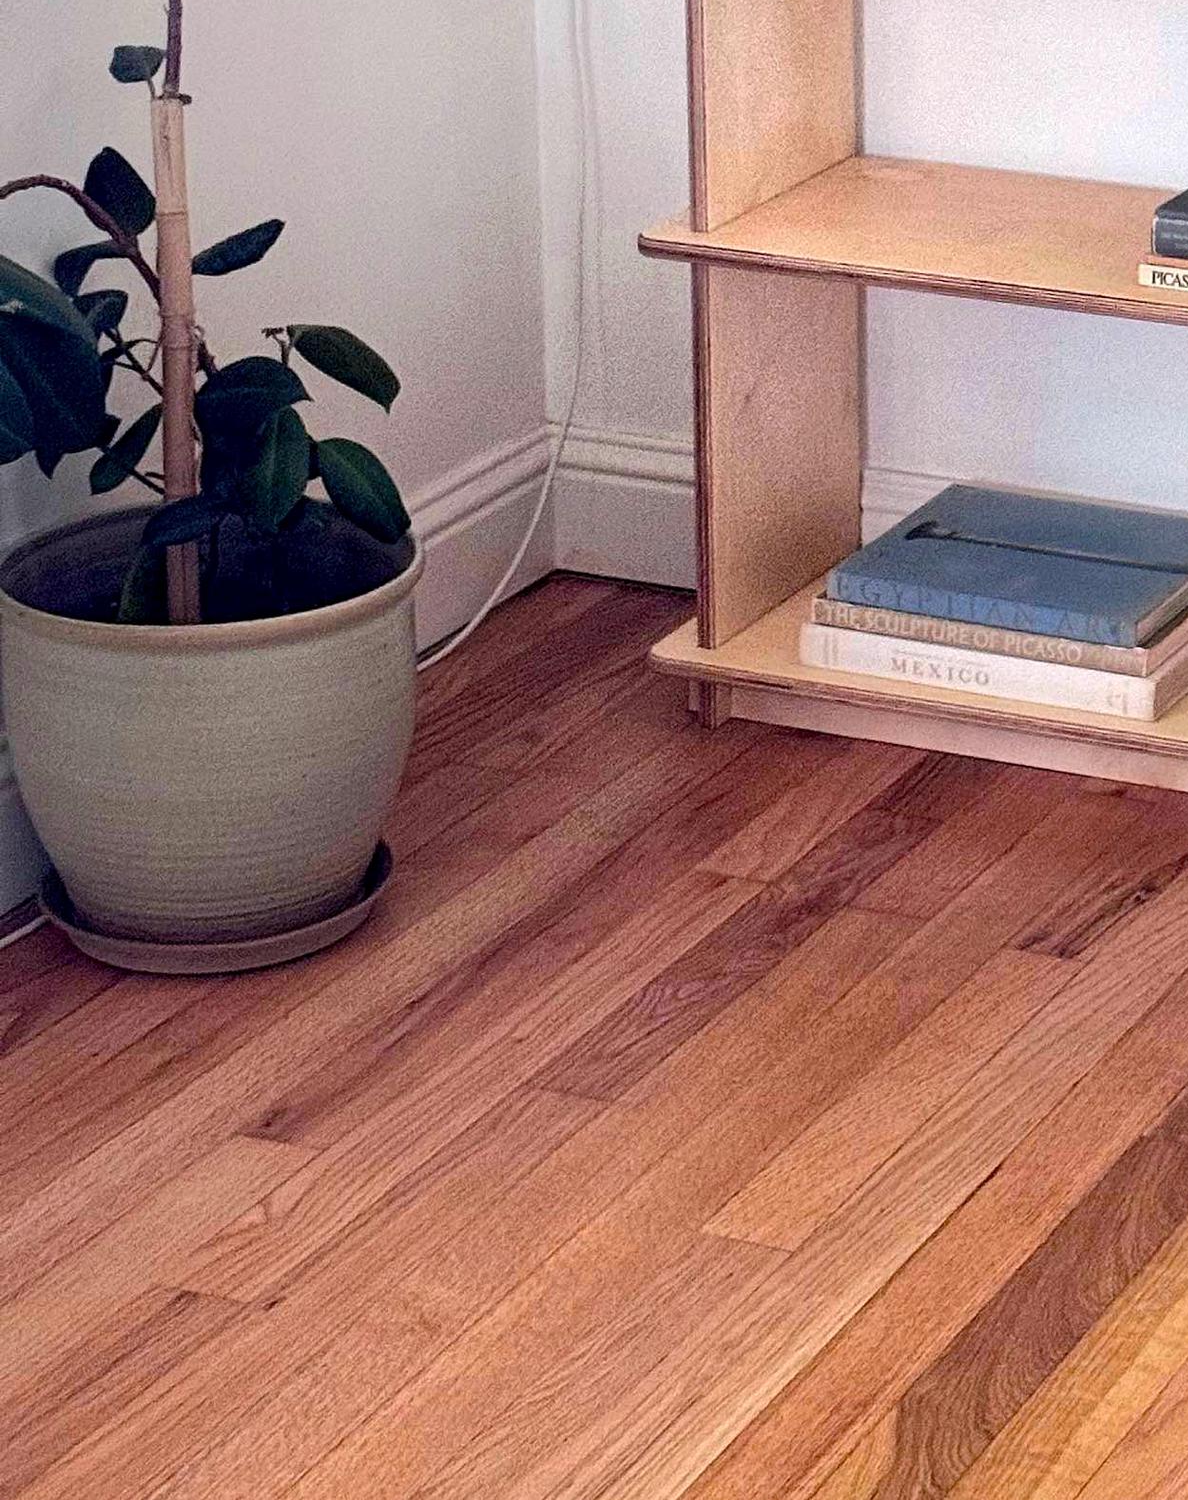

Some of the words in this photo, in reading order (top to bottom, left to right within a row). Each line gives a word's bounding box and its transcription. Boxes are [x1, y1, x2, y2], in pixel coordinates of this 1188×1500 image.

[825, 605, 859, 625] THE
[862, 609, 969, 646] SCULPTURE
[973, 630, 1000, 650] OF
[1004, 634, 1081, 663] PICASSO
[890, 657, 990, 687] MEXICO
